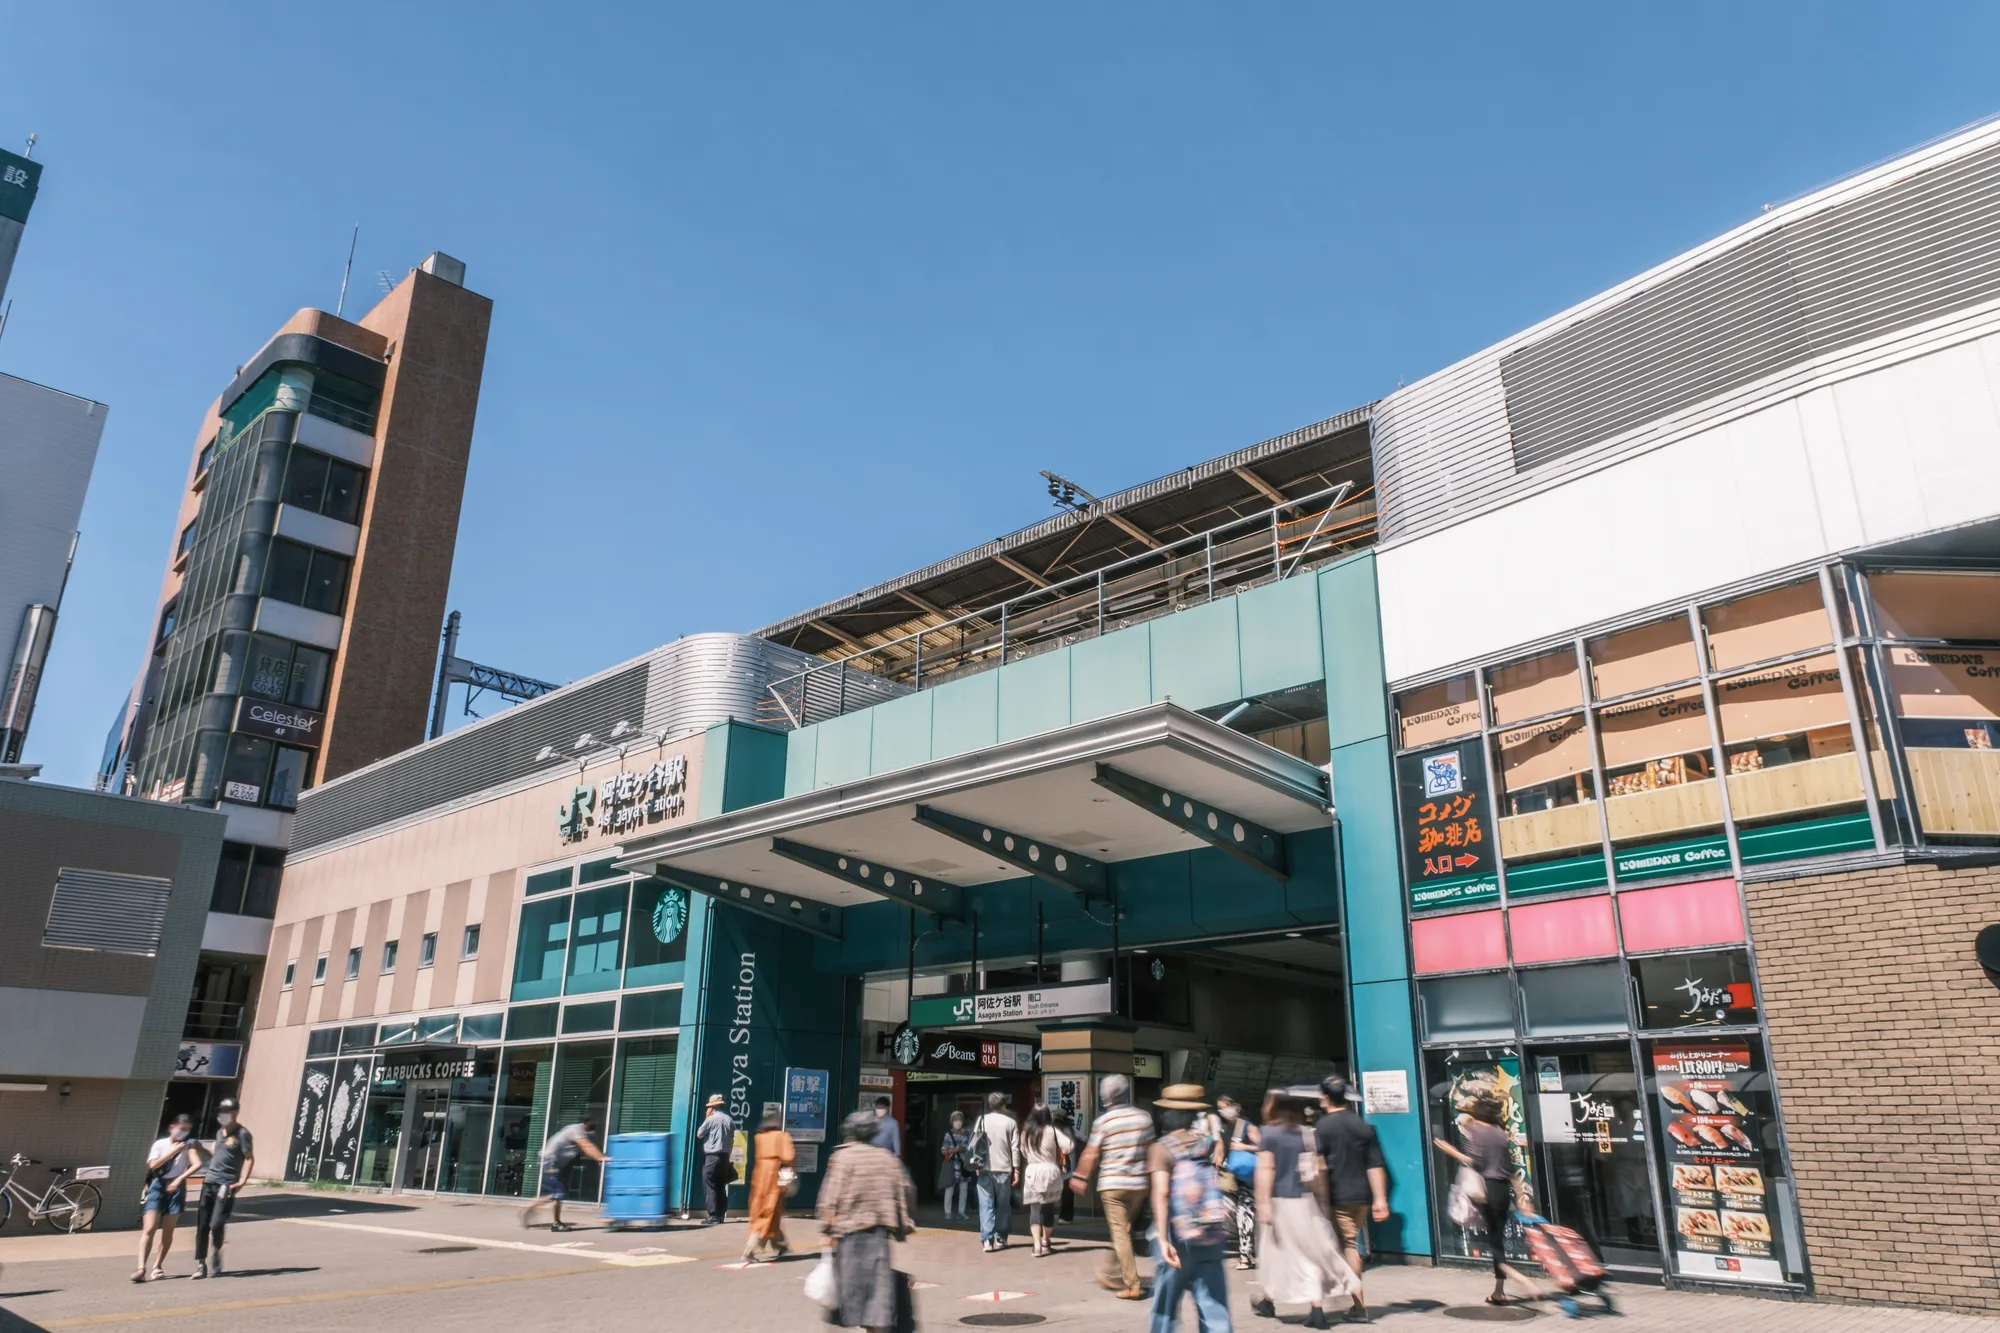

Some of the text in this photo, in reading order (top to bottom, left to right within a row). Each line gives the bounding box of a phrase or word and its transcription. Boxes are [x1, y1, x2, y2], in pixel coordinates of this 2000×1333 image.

[275, 727, 286, 736] 4F
[557, 783, 595, 826] JR
[643, 792, 683, 816] Sation
[1418, 793, 1476, 826] コメダ
[1418, 817, 1482, 853] 珈琲店
[1423, 855, 1453, 876] 入口
[1619, 849, 1726, 871] KOMEDA'S Coffee
[1414, 882, 1497, 902] KOMEDA'S Coffee
[729, 952, 756, 1045] Station
[953, 998, 974, 1016] JR
[977, 1009, 1023, 1020] Asagaya Station
[948, 1044, 977, 1061] Beans
[982, 1044, 996, 1054] UNI
[982, 1055, 997, 1065] QLO
[375, 1060, 476, 1083] STARBUCKS COFFEE
[791, 1075, 825, 1094] 衝撃。
